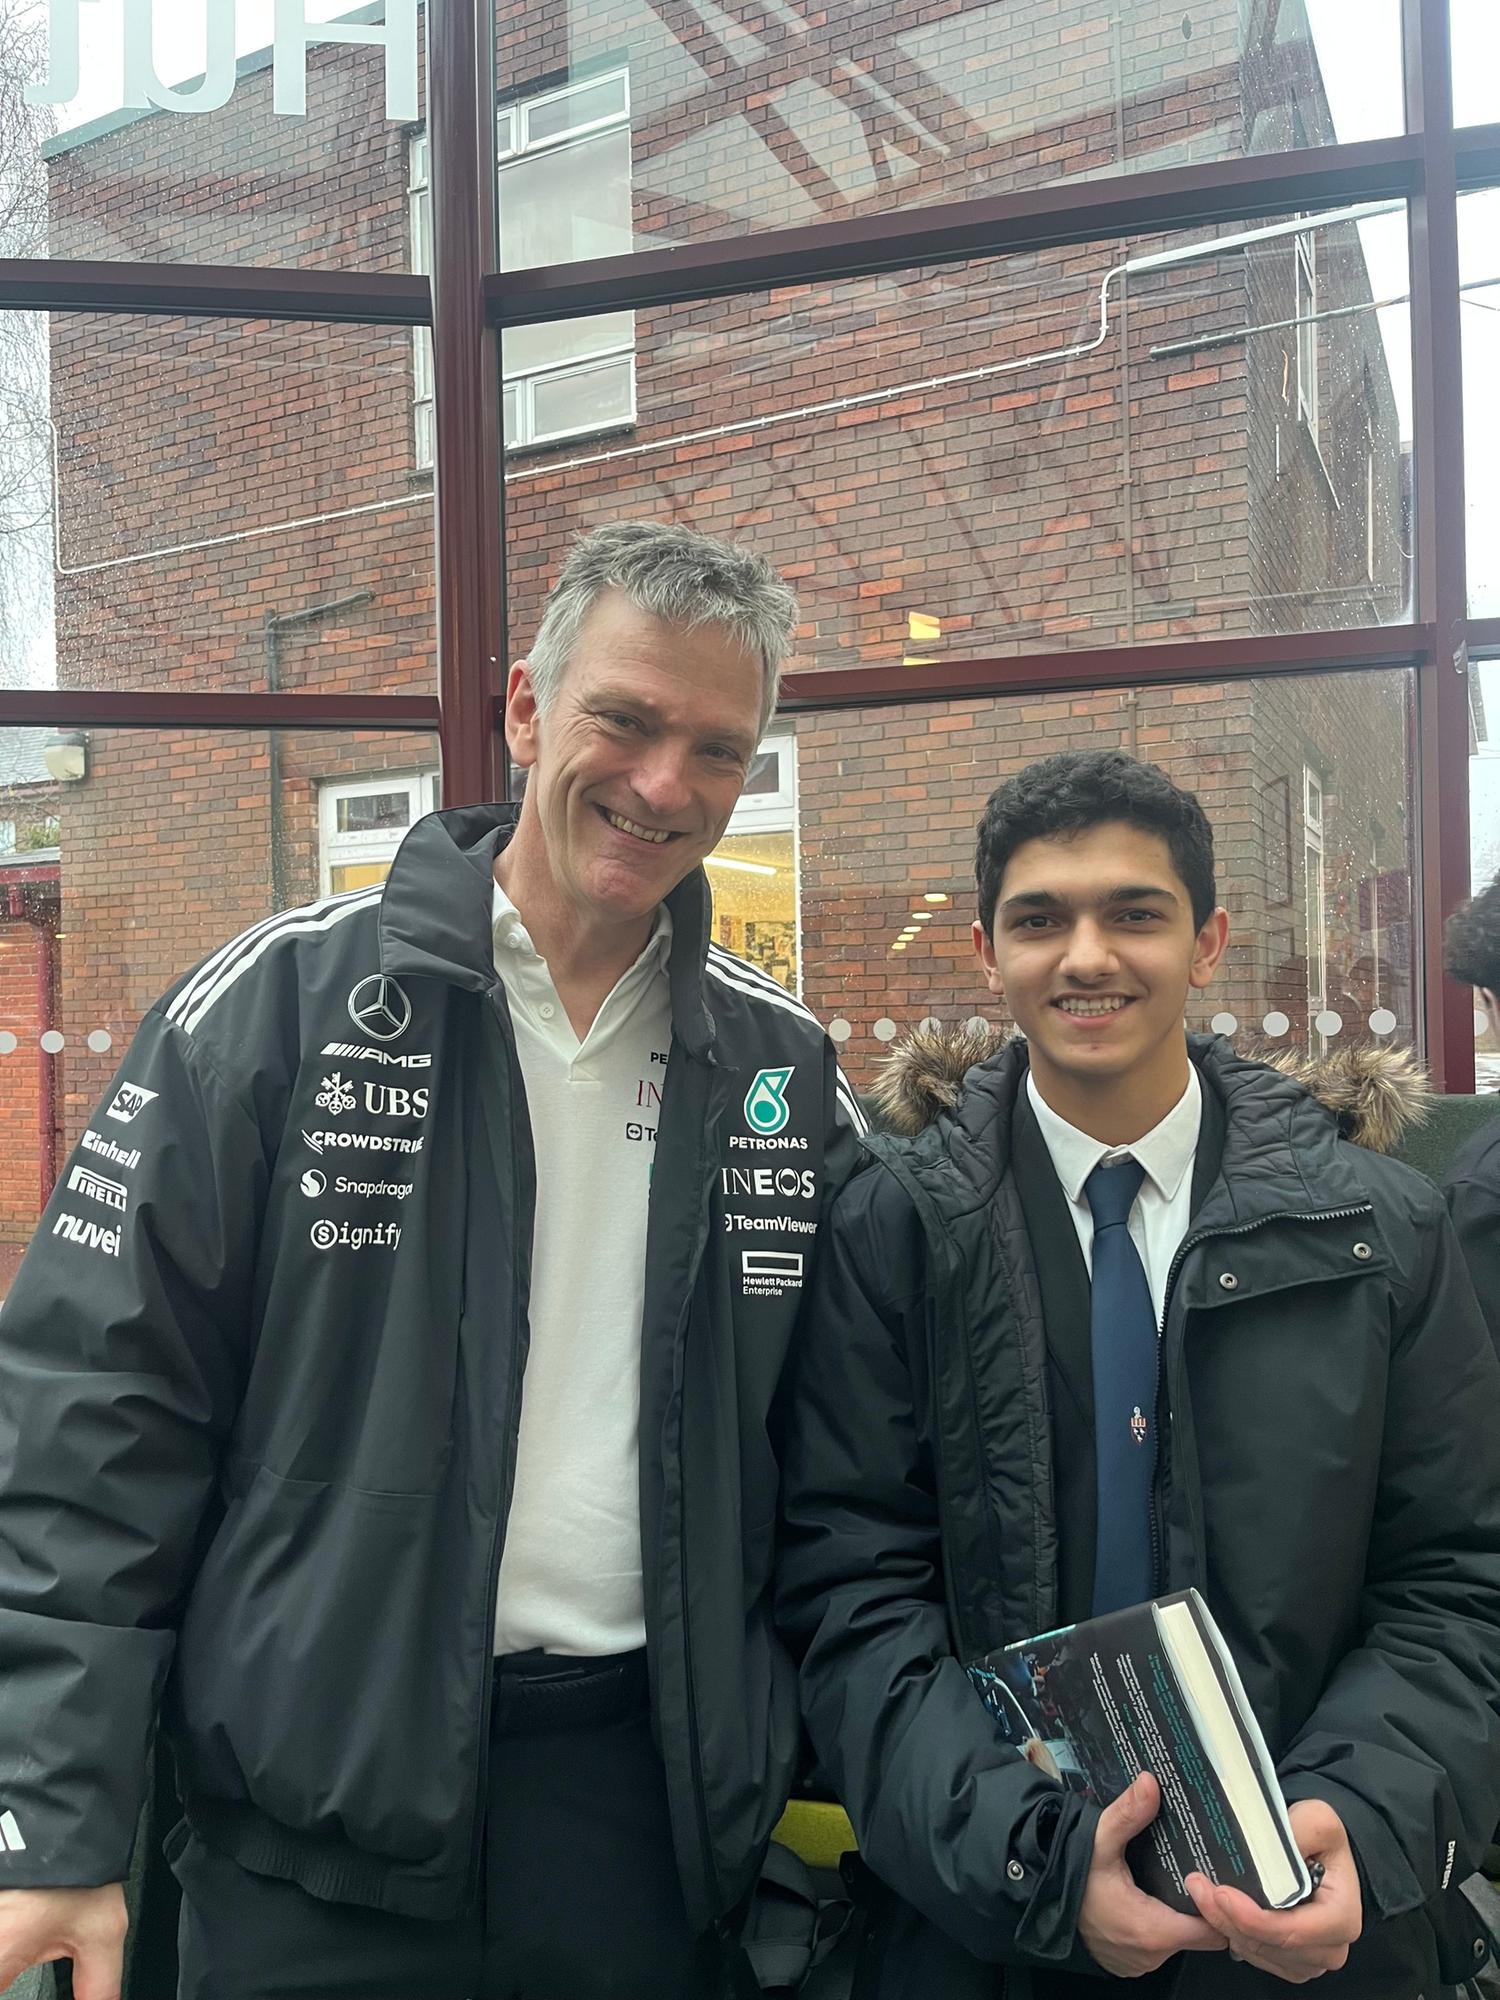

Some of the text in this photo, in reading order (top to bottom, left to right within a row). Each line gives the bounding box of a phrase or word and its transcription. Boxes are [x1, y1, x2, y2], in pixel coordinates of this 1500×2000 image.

[359, 1047, 432, 1068] AMG
[112, 1088, 143, 1118] SAP
[363, 1081, 429, 1118] UBS
[81, 1129, 142, 1170] Einhell
[729, 1135, 808, 1150] PETRONAS
[67, 1165, 128, 1213] PIRELLI
[721, 1167, 816, 1199] INEOS
[52, 1213, 122, 1257] nuvei
[733, 1214, 817, 1235] TeamViewer
[743, 1276, 802, 1288] Hewlett Packard
[743, 1286, 783, 1297] Enterprise
